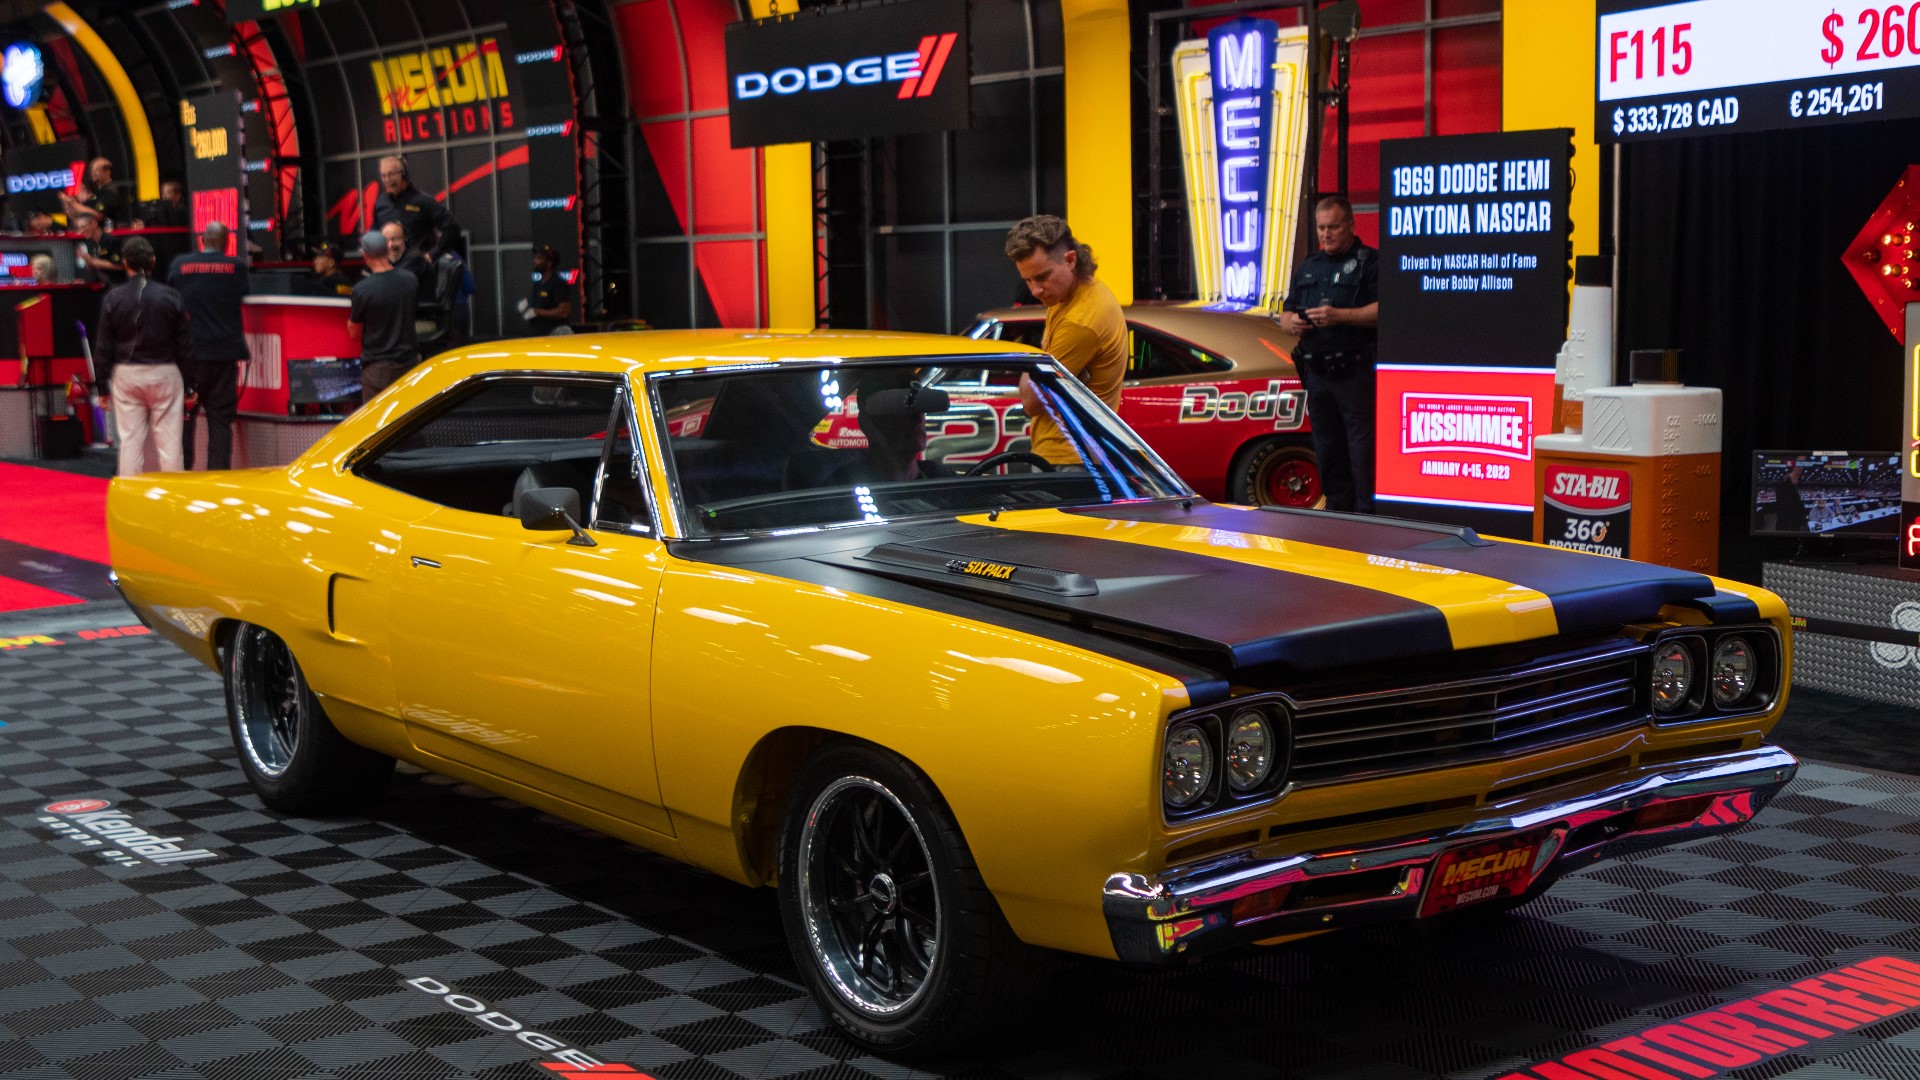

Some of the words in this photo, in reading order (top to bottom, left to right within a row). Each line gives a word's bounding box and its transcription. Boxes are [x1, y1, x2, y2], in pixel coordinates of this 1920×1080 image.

[1609, 23, 1692, 83] F115
[1821, 8, 1844, 69] $
[370, 38, 508, 115] MECUM
[736, 51, 922, 99] DODGE
[1613, 106, 1625, 136] $
[1628, 102, 1693, 133] 333,728
[1697, 97, 1739, 126] CAD
[1790, 91, 1802, 118] €
[1806, 82, 1884, 117] 254,261
[384, 102, 513, 143] AUCTIONS
[7, 169, 75, 193] DODGE
[1218, 30, 1264, 301] MECUM
[1393, 165, 1434, 196] 1969
[1440, 162, 1498, 194] DODGE
[1504, 159, 1551, 192] HEMI
[1390, 203, 1470, 236] DAYTONA
[1476, 201, 1551, 233] NASCAR
[1402, 255, 1429, 271] Driven
[1431, 255, 1442, 271] by
[1444, 255, 1479, 269] NASCAR
[1481, 254, 1498, 268] Hall
[1501, 254, 1510, 267] of
[1512, 254, 1538, 268] Fame
[1423, 275, 1449, 290] Driver
[1451, 275, 1479, 292] Bobby
[1482, 275, 1513, 290] Allison
[1179, 380, 1310, 431] Dodg
[1410, 412, 1523, 450] KISSIMMEE
[1422, 461, 1460, 476] JANUARY
[1462, 463, 1484, 479] 4-15,
[1486, 464, 1510, 480] 2023
[1553, 473, 1620, 500] STA-BIL
[38, 816, 103, 846] MOTOR
[103, 850, 142, 867] OIL
[1442, 848, 1531, 886] MECUM
[1456, 885, 1500, 906] MECUM.COM
[406, 976, 605, 1071] DODGE
